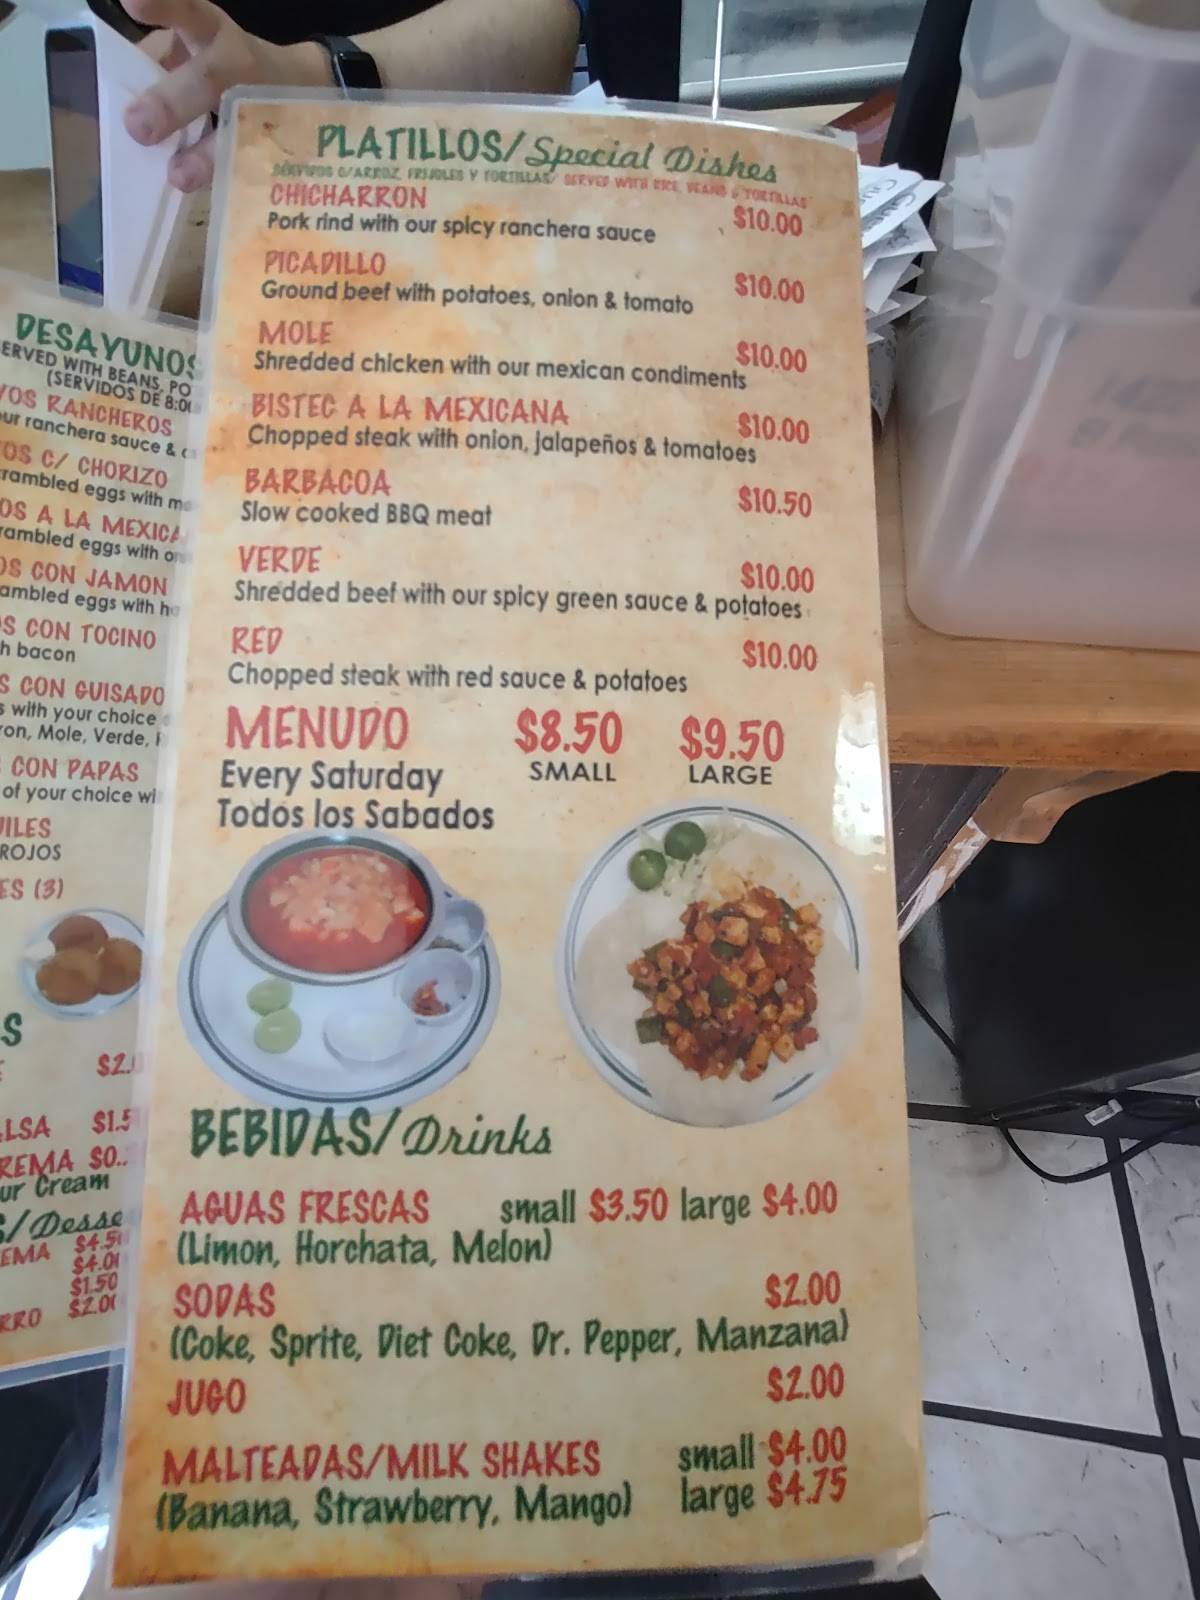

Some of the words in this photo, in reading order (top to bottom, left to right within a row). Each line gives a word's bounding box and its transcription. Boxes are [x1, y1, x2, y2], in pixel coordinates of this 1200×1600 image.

[317, 124, 526, 163] PLATILLOS/
[525, 136, 655, 173] Special
[664, 146, 777, 183] Dishes
[469, 169, 478, 182] Y
[270, 184, 428, 209] CHICHARRON
[268, 212, 308, 230] Pork
[316, 213, 353, 231] rind
[360, 214, 398, 232] with
[405, 218, 436, 233] our
[443, 216, 495, 238] spicy
[500, 219, 590, 240] ranchera
[596, 225, 656, 243] sauce
[734, 205, 803, 236] $10.00
[264, 250, 386, 276] PICADILLO
[261, 280, 337, 300] Ground
[344, 281, 391, 301] beef
[396, 282, 435, 302] with
[442, 284, 535, 308] potatoes,
[542, 288, 598, 309] onion
[604, 291, 617, 310] &
[624, 291, 693, 314] tomato
[735, 272, 804, 304] $10.00
[259, 320, 333, 344] MOLE
[63, 356, 103, 377] WITH
[254, 350, 354, 372] Shredded
[361, 352, 444, 374] chicken
[450, 355, 490, 375] with
[497, 360, 530, 377] our
[536, 359, 625, 381] mexican
[631, 365, 746, 390] condiments
[736, 341, 807, 373] $10.00
[47, 369, 134, 402] (SERVIDOS
[141, 390, 160, 407] DE
[48, 394, 172, 437] RANCHEROS
[252, 392, 338, 418] BISTEC
[348, 394, 366, 419] A
[379, 394, 412, 420] LA
[425, 396, 569, 425] MEXICANA
[25, 416, 106, 443] ranchera
[111, 434, 160, 453] sauce
[166, 442, 176, 456] &
[248, 424, 348, 450] Chopped
[354, 427, 411, 448] steak
[417, 428, 458, 449] with
[465, 429, 528, 452] onion,
[534, 430, 637, 457] jalapeños
[644, 437, 657, 456] &
[663, 437, 756, 463] tomatoes
[738, 412, 810, 444] $10.00
[42, 449, 69, 469] C/
[78, 456, 168, 489] CHORIZO
[245, 467, 391, 496] BARBACOA
[85, 483, 125, 503] eggs
[131, 490, 162, 508] with
[738, 485, 812, 518] $10.50
[37, 505, 53, 525] A
[64, 508, 90, 530] LA
[241, 500, 290, 522] Slow
[295, 502, 379, 524] cooked
[386, 504, 429, 526] BBQ
[436, 505, 492, 526] meat
[80, 538, 121, 558] eggs
[127, 544, 159, 560] with
[238, 545, 322, 573] VERDE
[32, 561, 75, 584] CON
[85, 568, 168, 596] JAMON
[741, 560, 815, 594] $10.00
[75, 594, 117, 614] eggs
[122, 598, 154, 614] with
[234, 579, 340, 603] Shredded
[347, 580, 397, 604] beef
[403, 582, 445, 605] with
[452, 589, 487, 606] our
[493, 584, 549, 612] spicy
[556, 590, 617, 613] green
[625, 593, 688, 612] sauce
[695, 592, 708, 613] &
[715, 594, 802, 620] potatoes
[26, 618, 71, 641] CON
[81, 623, 157, 650] TOCINO
[231, 626, 283, 655] RED
[17, 641, 75, 663] bacon
[742, 639, 817, 672] $10.00
[20, 675, 65, 698] CON
[75, 680, 166, 706] GUISADO
[228, 661, 334, 691] Chopped
[340, 662, 400, 686] steak
[406, 663, 449, 688] with
[456, 664, 493, 688] red
[500, 670, 565, 691] sauce
[573, 668, 586, 690] &
[594, 668, 687, 697] potatoes
[12, 701, 47, 719] with
[53, 706, 92, 723] your
[98, 707, 156, 726] choice
[225, 705, 409, 750] MENUDO
[38, 723, 87, 745] Mole,
[94, 727, 150, 747] Verde,
[514, 707, 623, 755] $8.50
[678, 714, 784, 762] $9.50
[11, 756, 58, 778] CON
[67, 758, 139, 782] PAPAS
[220, 759, 302, 796] Every
[311, 759, 444, 798] Saturday
[529, 761, 616, 782] SMALL
[688, 764, 773, 786] LARGE
[2, 782, 20, 799] of
[26, 785, 66, 803] your
[72, 785, 132, 804] choice
[217, 798, 304, 828] Todos
[314, 798, 354, 829] los
[364, 798, 495, 829] Sabados
[34, 878, 64, 900] (3)
[190, 1106, 402, 1158] BEBIDAS/
[401, 1113, 552, 1157] Drinks
[36, 1173, 109, 1198] Cream
[179, 1189, 286, 1226] AGUAS
[299, 1188, 429, 1225] FRESCAS
[500, 1189, 576, 1224] small
[589, 1186, 668, 1223] $3.50
[680, 1186, 751, 1226] large
[762, 1180, 838, 1218] $4.00
[176, 1230, 280, 1267] (Limon,
[295, 1228, 438, 1267] Horchata,
[452, 1227, 552, 1264] Melon)
[70, 1271, 118, 1297] $1.50
[173, 1282, 276, 1319] SODAS
[765, 1270, 841, 1309] $2.00
[170, 1324, 255, 1363] (Coke,
[270, 1323, 363, 1367] Sprite,
[378, 1323, 432, 1358] Diet
[444, 1321, 516, 1361] Coke,
[531, 1320, 571, 1356] Dr.
[584, 1317, 683, 1362] Pepper,
[696, 1308, 849, 1352] Manzana)
[167, 1378, 246, 1416] JUGO
[767, 1362, 845, 1402] $2.00
[161, 1441, 469, 1485] MALTEADAS/MILK
[482, 1440, 600, 1479] SHAKES
[678, 1433, 755, 1472] small
[767, 1426, 847, 1467] $4.00
[156, 1491, 299, 1532] (Banana,
[314, 1486, 498, 1529] Strawberry,
[515, 1480, 632, 1526] Mango)
[680, 1476, 755, 1517] large
[767, 1465, 847, 1509] $4.75
